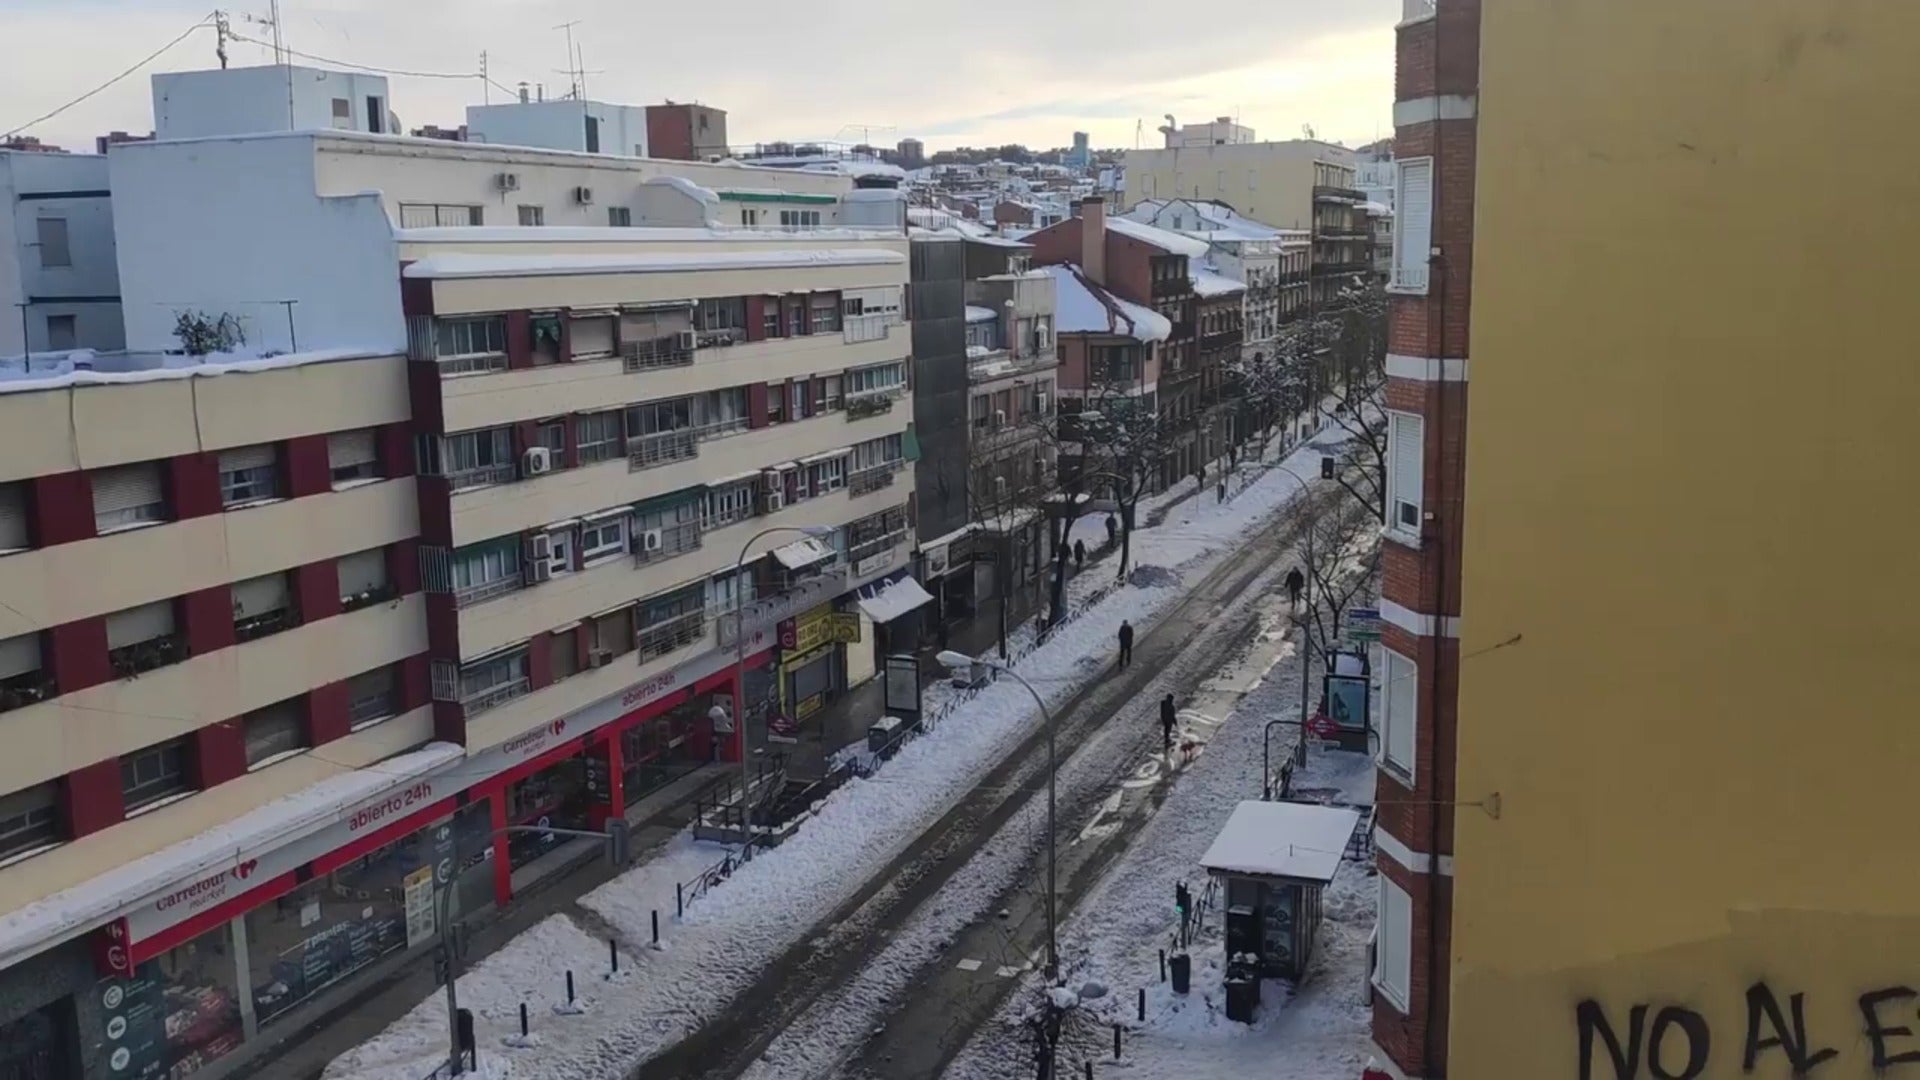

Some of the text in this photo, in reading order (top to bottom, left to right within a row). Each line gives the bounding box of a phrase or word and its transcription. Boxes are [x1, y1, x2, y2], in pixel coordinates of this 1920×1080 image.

[622, 671, 676, 706] abierto 24h
[349, 782, 432, 831] abierto 24h
[156, 871, 226, 911] Carrefour
[189, 884, 226, 911] market
[1576, 981, 1920, 1080] NO AL E
